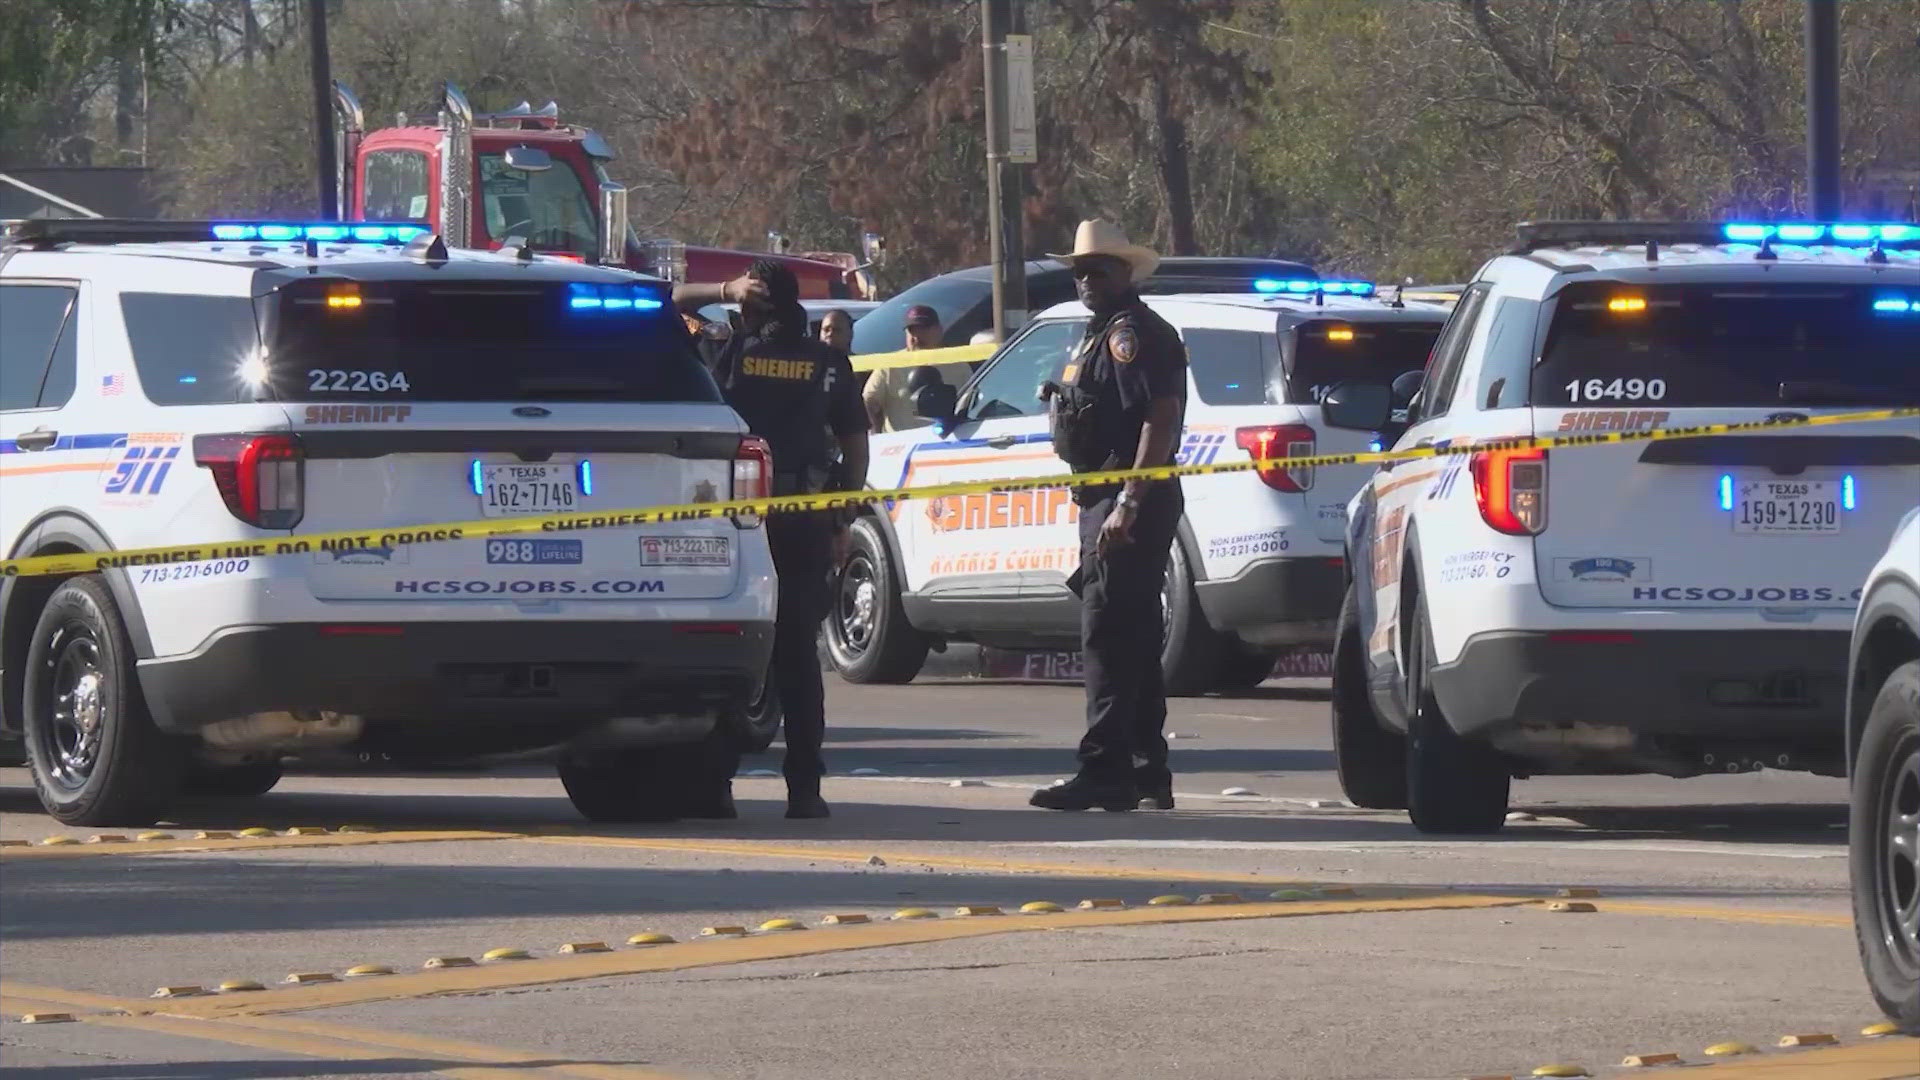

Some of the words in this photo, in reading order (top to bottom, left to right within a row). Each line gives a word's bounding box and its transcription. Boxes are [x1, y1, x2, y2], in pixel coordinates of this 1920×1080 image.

[742, 356, 815, 380] SHERIFF
[308, 369, 411, 392] 22264
[1564, 378, 1667, 402] 16490
[304, 405, 412, 425] SHERIFF
[1558, 411, 1670, 432] SHERIFF
[105, 446, 181, 495] 911
[509, 467, 546, 478] TEXAS
[1768, 484, 1808, 495] TEXAS
[321, 536, 371, 551] NOT
[1231, 530, 1287, 545] EMERGENCY
[489, 541, 534, 562] 988
[541, 551, 580, 560] LIFELINE
[395, 580, 666, 594] HCSOJOBS.COM
[1632, 587, 1863, 602] HCSOJOBS.C
[1022, 652, 1084, 679] FIRE
